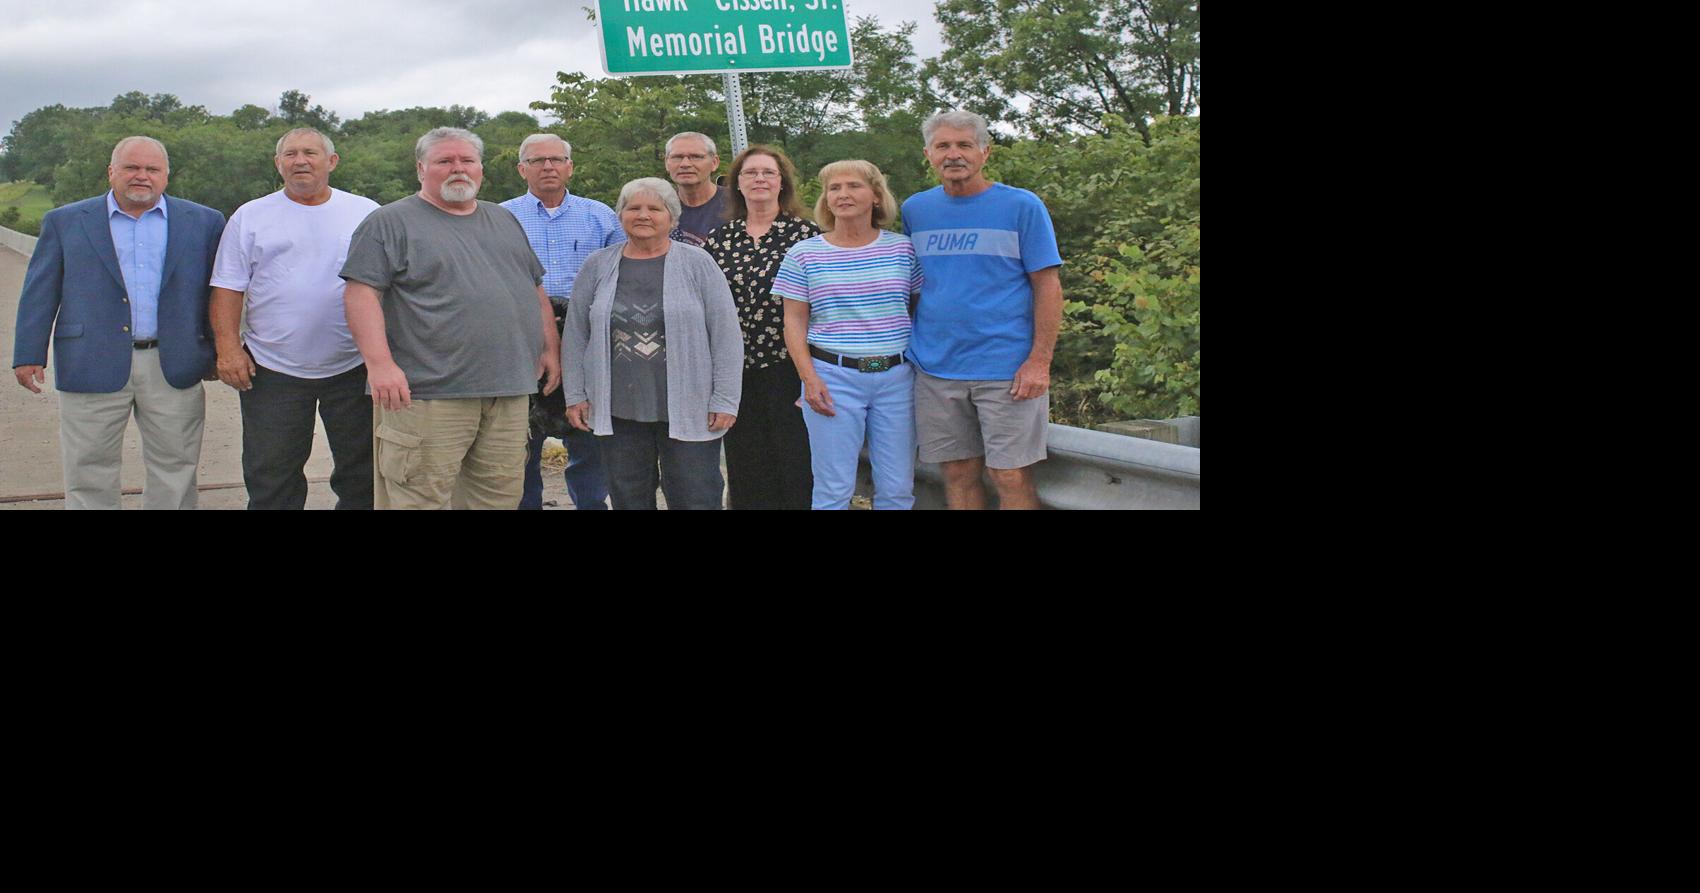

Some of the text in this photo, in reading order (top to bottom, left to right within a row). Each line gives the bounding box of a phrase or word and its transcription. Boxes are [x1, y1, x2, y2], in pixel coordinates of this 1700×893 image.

[626, 23, 838, 62] Memorial Bridge
[926, 232, 979, 251] PUMA
